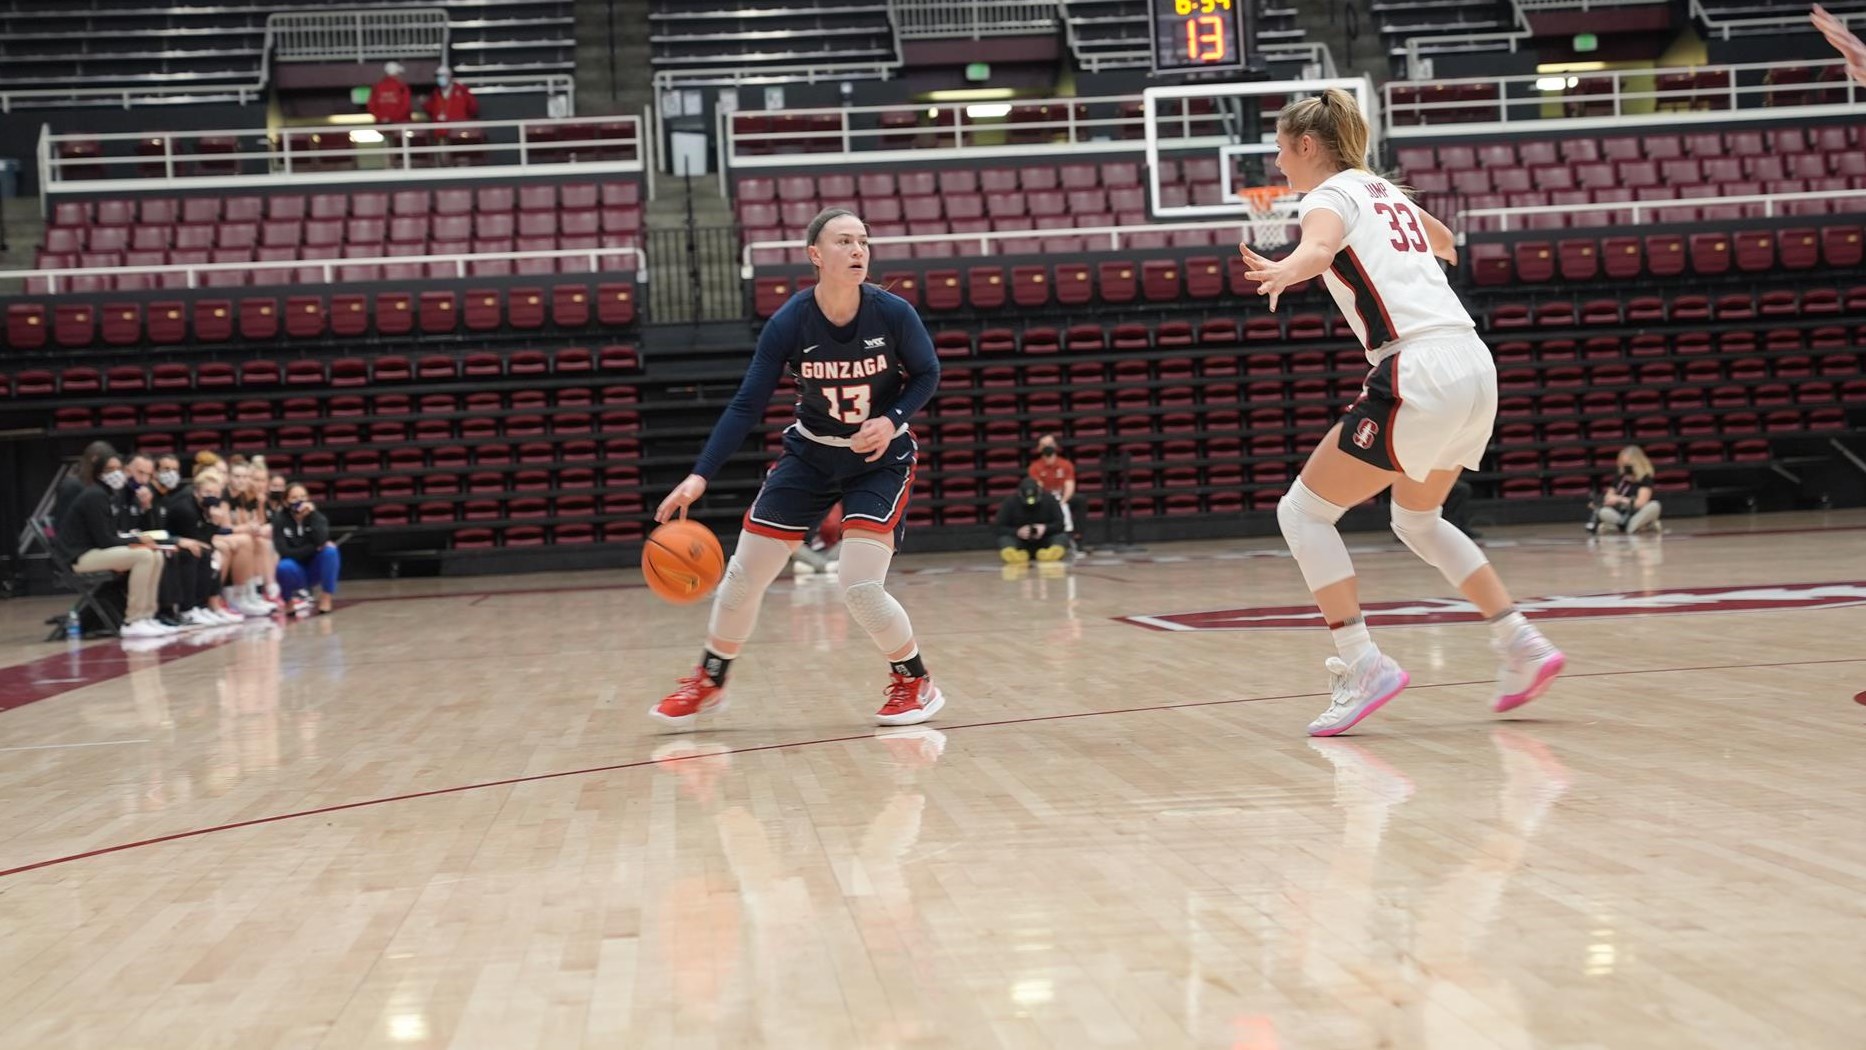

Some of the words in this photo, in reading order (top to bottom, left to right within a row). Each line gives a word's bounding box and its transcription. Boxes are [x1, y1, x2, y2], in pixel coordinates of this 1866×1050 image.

[1186, 16, 1224, 60] 13
[1373, 202, 1428, 253] 33
[801, 354, 888, 379] GONZAGA
[821, 384, 871, 424] 13
